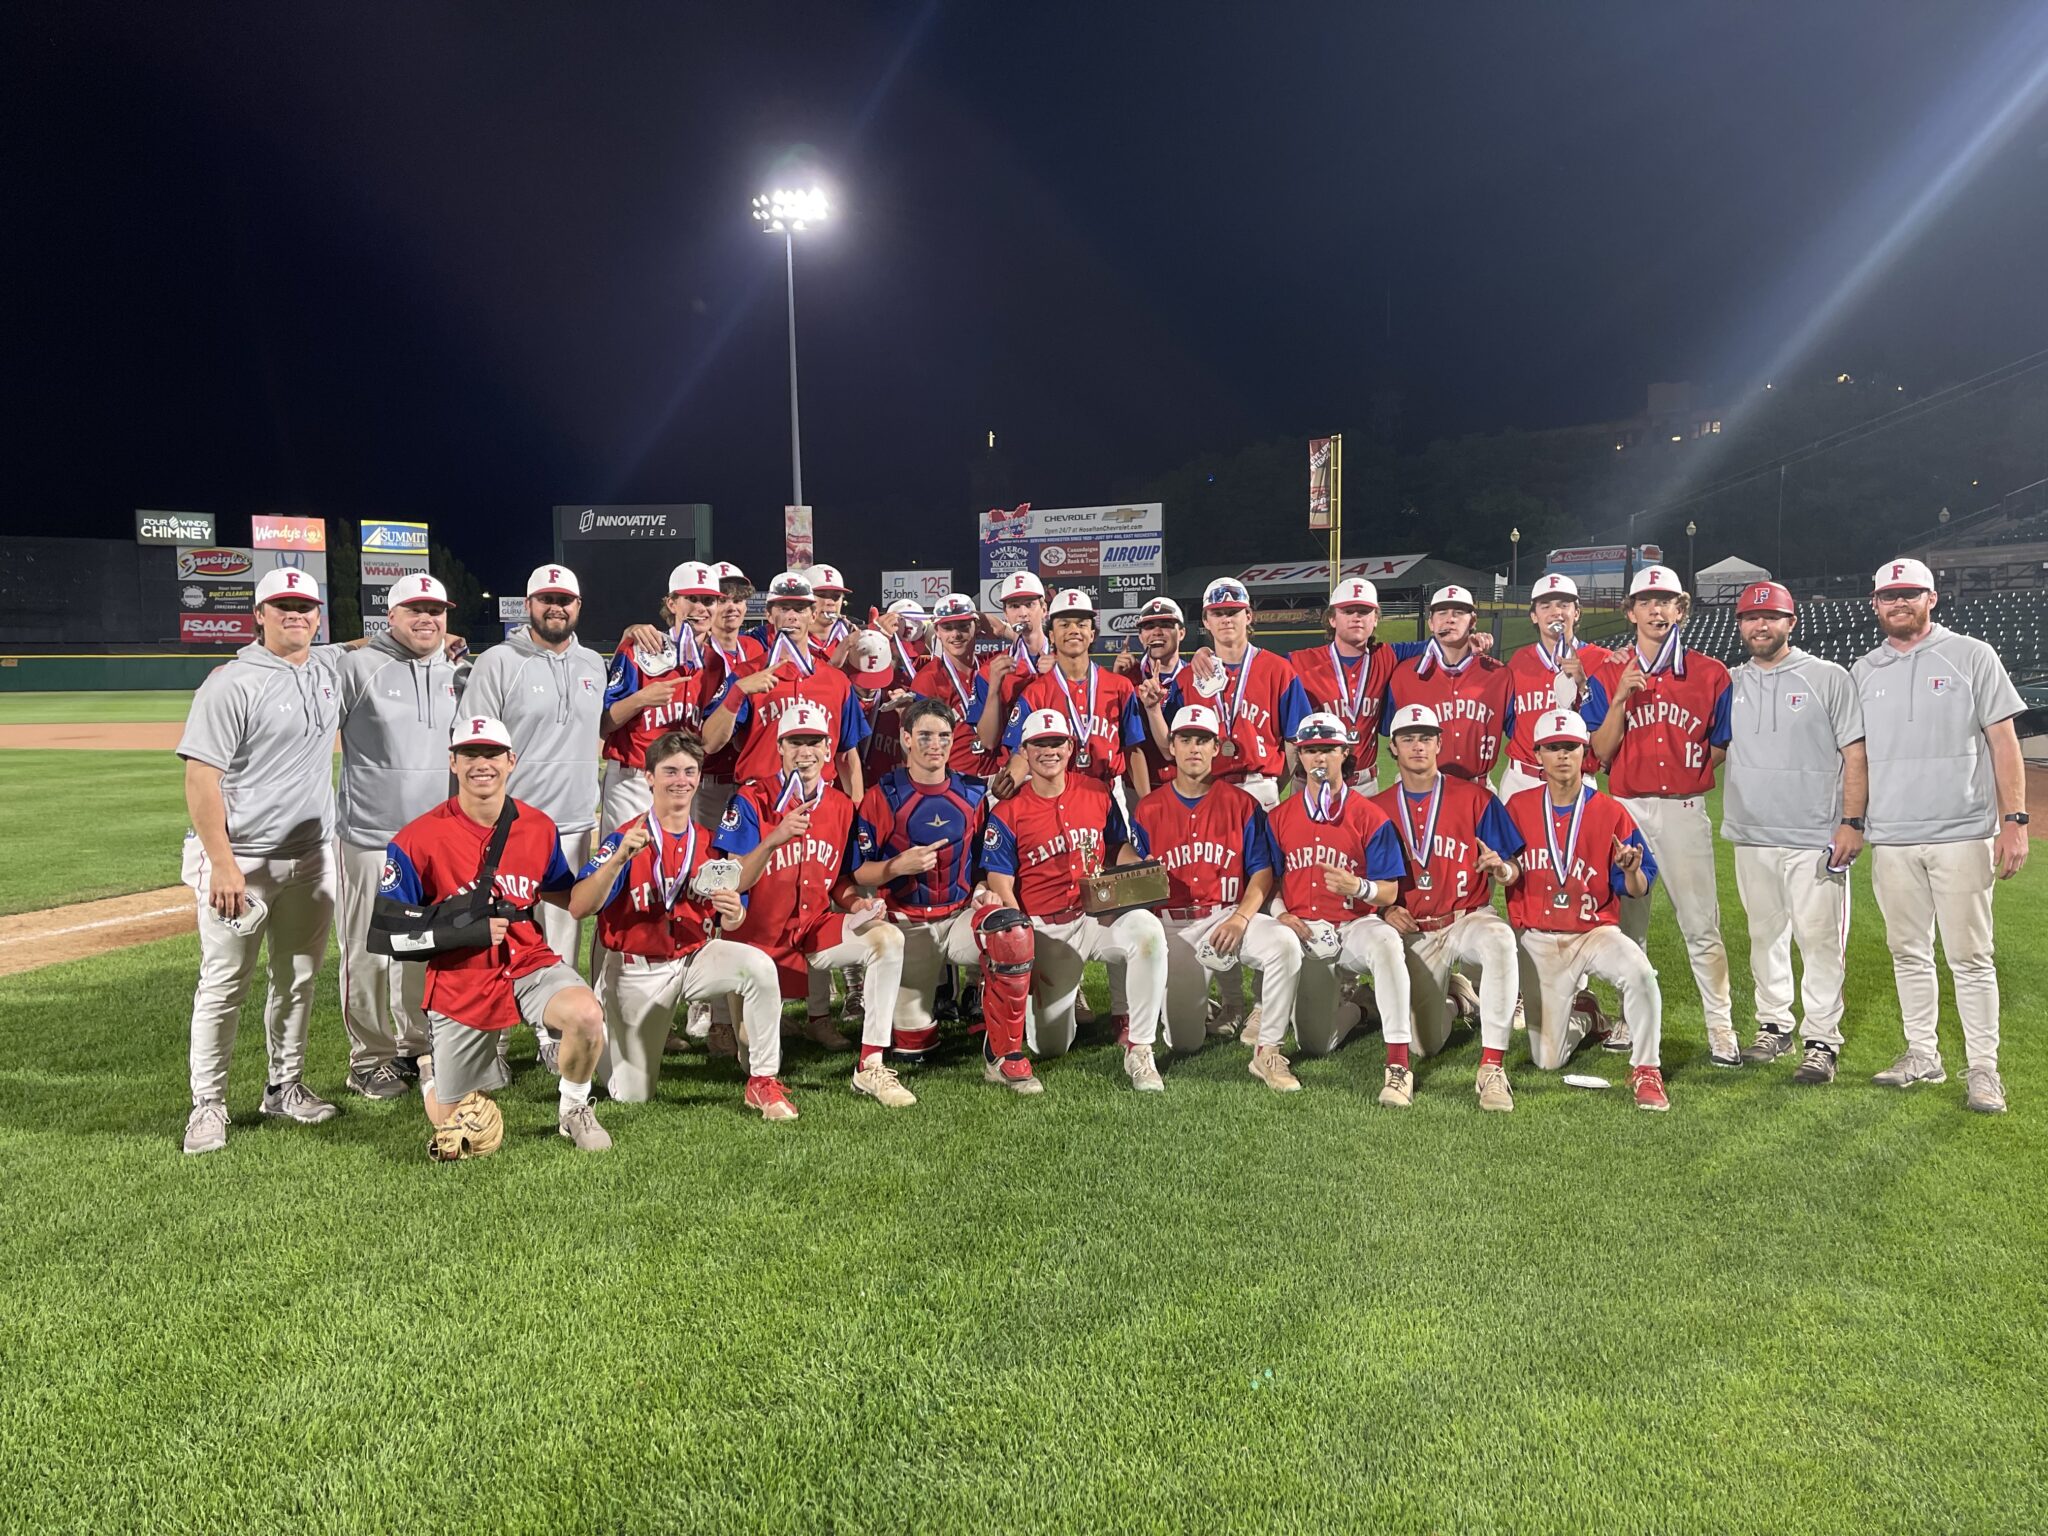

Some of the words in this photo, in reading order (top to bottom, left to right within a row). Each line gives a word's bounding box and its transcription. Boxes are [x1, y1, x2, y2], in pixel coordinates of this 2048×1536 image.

[143, 518, 168, 526] FOUR
[179, 519, 209, 528] WINDS
[596, 514, 667, 527] INNOVATIVE
[1044, 513, 1097, 522] CHEVROLET
[140, 525, 212, 540] CHIMNEY
[255, 525, 301, 543] Wendy's
[380, 531, 427, 544] SUMMIT
[630, 529, 677, 537] FIELD
[1045, 527, 1058, 535] Open
[1059, 526, 1072, 534] 24/7
[989, 545, 1030, 558] CAMERON
[1103, 545, 1161, 562] AIRQUIP
[549, 569, 561, 583] F
[696, 569, 707, 584] F
[720, 564, 729, 577] F
[824, 569, 834, 583] F
[1237, 560, 1408, 581] RE/MAX
[1891, 564, 1905, 580] F
[285, 572, 300, 588] F
[420, 578, 432, 592] F
[1015, 575, 1025, 589] F
[1108, 574, 1155, 588] 2touch
[1550, 577, 1560, 588] F
[1649, 571, 1661, 585] F
[1058, 585, 1099, 595] Flink
[1353, 584, 1363, 598] F
[1448, 587, 1458, 598] F
[1754, 588, 1769, 604] F
[1068, 592, 1079, 605] F
[183, 619, 242, 632] ISAAC
[868, 656, 878, 669] F
[583, 680, 591, 690] F
[1933, 679, 1945, 690] F
[323, 688, 332, 699] F
[1790, 695, 1802, 706] F
[643, 702, 704, 732] FAIRPO
[798, 710, 810, 724] F
[1190, 708, 1202, 722] F
[1412, 709, 1422, 722] F
[1434, 699, 1494, 724] IRPORT
[1625, 701, 1702, 736] AIRPORT
[472, 719, 487, 734] F
[1043, 714, 1054, 728] F
[1555, 716, 1567, 731] F
[1350, 731, 1358, 740] V
[1256, 735, 1267, 757] 6
[1479, 736, 1496, 760] 23
[1080, 754, 1088, 763] V
[1685, 742, 1703, 768] 12
[1518, 848, 1597, 887] FAIRRT
[1114, 870, 1141, 881] CLASS
[1421, 876, 1429, 886] V
[1221, 877, 1240, 902] 10
[1457, 871, 1468, 897] 2
[1557, 895, 1567, 905] V
[1579, 893, 1600, 921] 21
